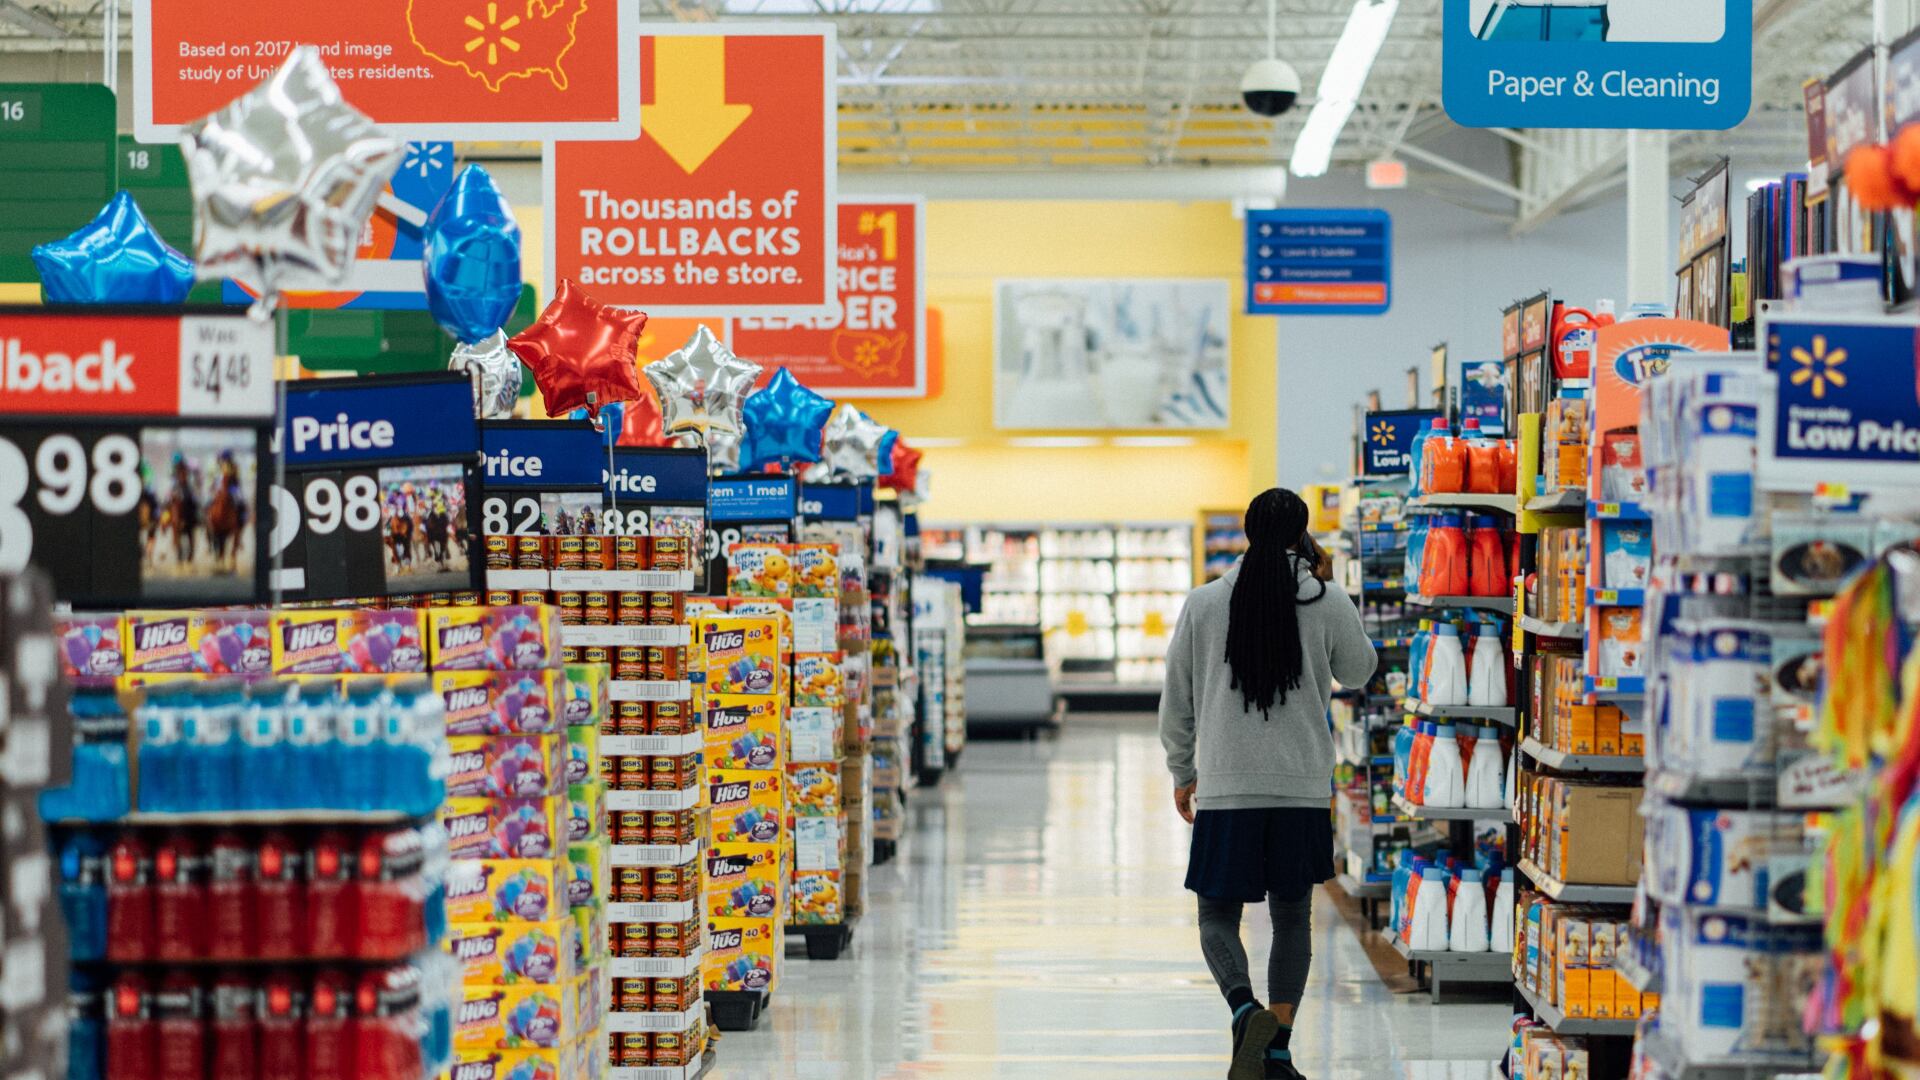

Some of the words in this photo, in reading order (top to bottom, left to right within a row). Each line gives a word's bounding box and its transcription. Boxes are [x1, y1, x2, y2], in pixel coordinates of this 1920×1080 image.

[179, 43, 225, 56] Based
[231, 46, 249, 56] on
[255, 41, 290, 56] 2017
[345, 41, 392, 60] image
[179, 65, 222, 83] study
[227, 65, 243, 79] of
[358, 65, 434, 79] residents.
[1488, 70, 1567, 102] Paper
[1573, 70, 1594, 97] &
[1601, 70, 1720, 105] Cleaning
[1, 101, 24, 121] 16
[128, 151, 149, 170] 18
[579, 189, 752, 220] Thousands
[761, 189, 799, 220] of
[580, 227, 801, 256] ROLLBACKS
[857, 210, 898, 261] #1
[579, 265, 666, 284] across
[673, 259, 719, 284] the
[726, 261, 803, 284] store.
[837, 266, 898, 292] RICE
[293, 412, 395, 453] Price
[1787, 420, 1856, 450] Low
[1373, 454, 1400, 468] Low
[747, 483, 754, 497] 1
[756, 483, 788, 497] meal
[482, 498, 541, 535] 82
[142, 623, 186, 650] HUG
[290, 624, 336, 650] HUG
[441, 627, 482, 648] HUG
[709, 633, 743, 651] HUG
[451, 688, 487, 711] HUG
[715, 785, 748, 803] HUG
[451, 815, 487, 838] HUG
[457, 936, 494, 959] HUG
[710, 933, 741, 949] HUG
[460, 1000, 497, 1023] HUG
